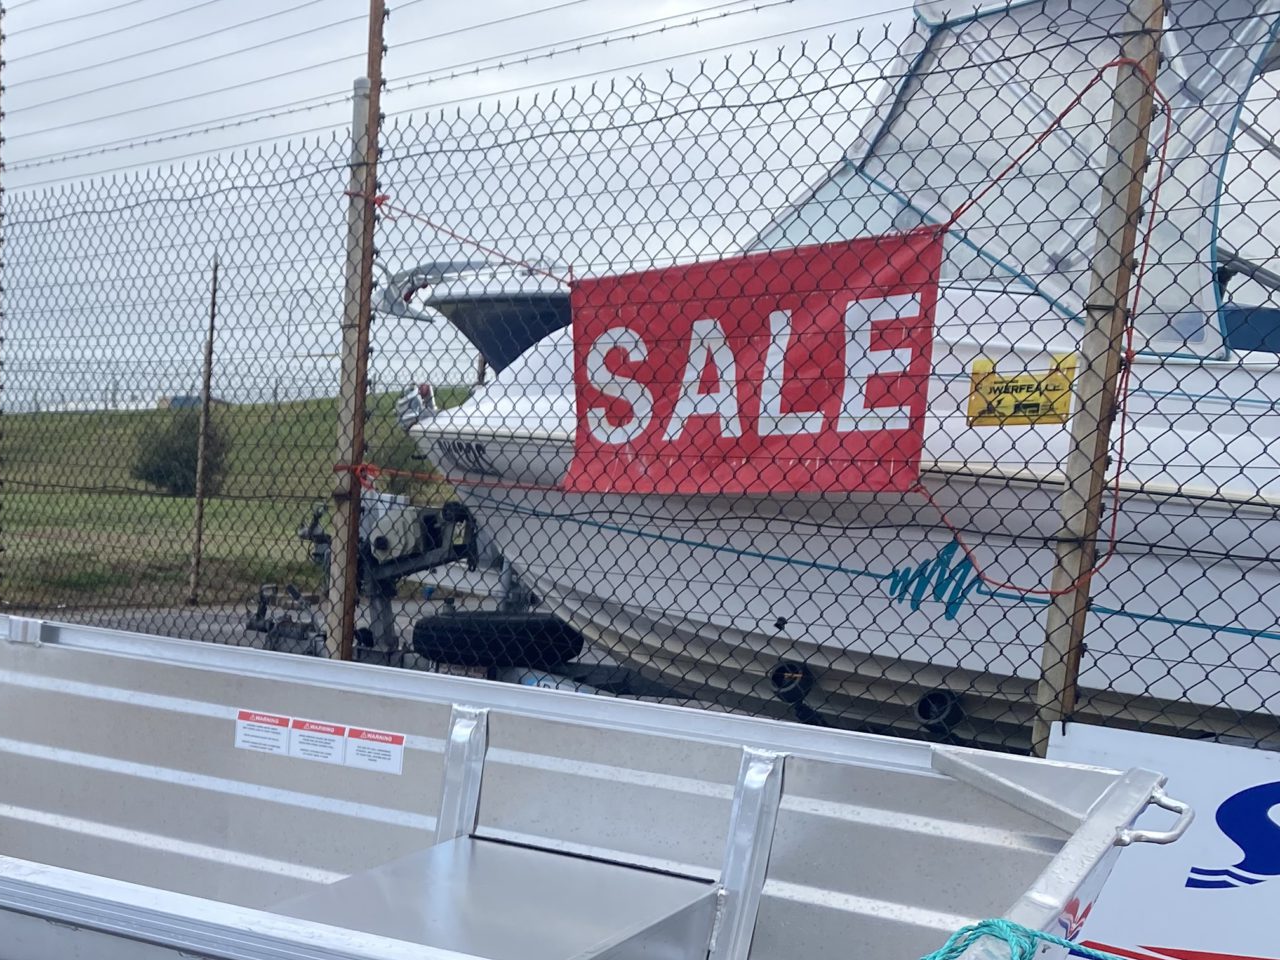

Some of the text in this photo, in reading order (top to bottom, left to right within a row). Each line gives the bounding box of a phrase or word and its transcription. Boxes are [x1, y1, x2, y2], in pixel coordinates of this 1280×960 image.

[584, 292, 924, 447] SALE
[255, 714, 280, 725] WARNING
[310, 723, 335, 734] WARNING
[367, 733, 393, 743] WARNING
